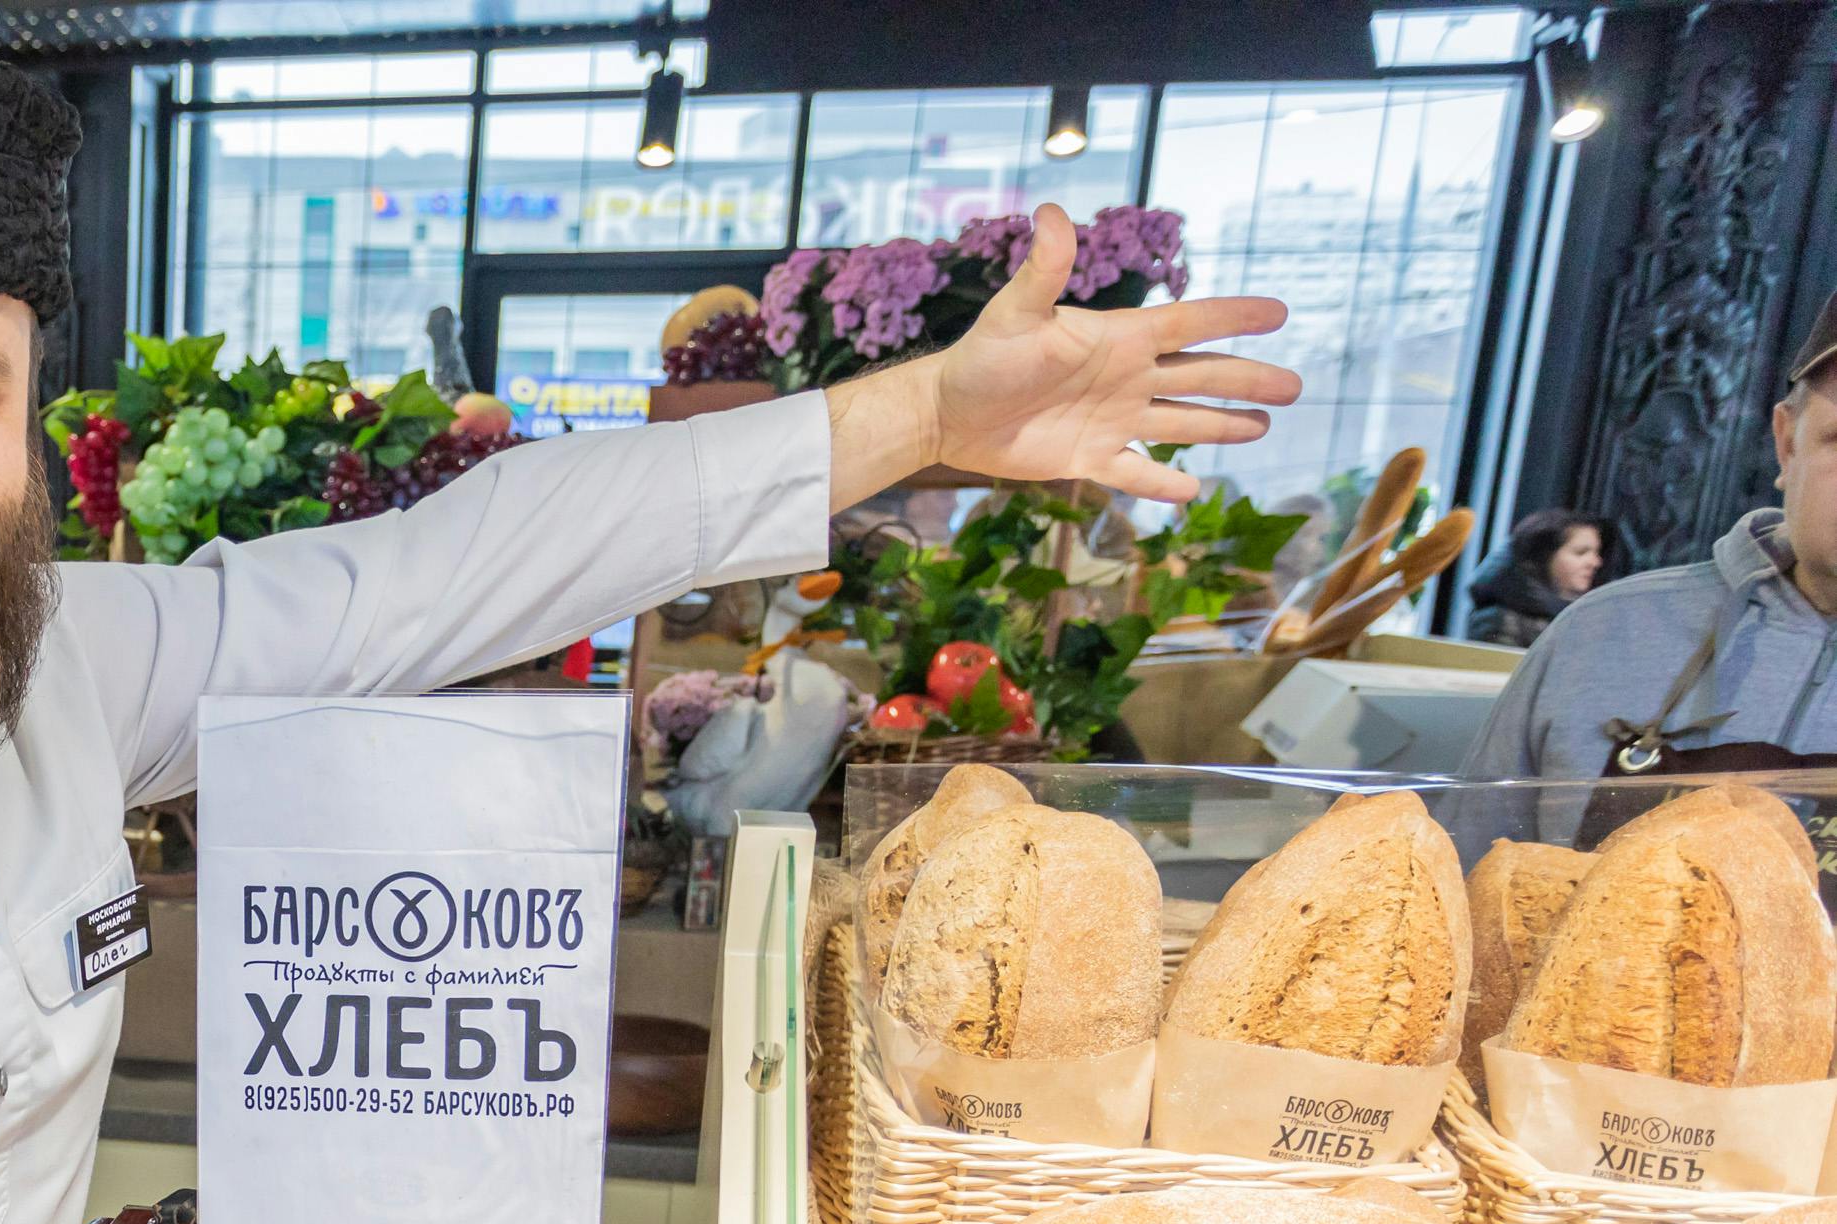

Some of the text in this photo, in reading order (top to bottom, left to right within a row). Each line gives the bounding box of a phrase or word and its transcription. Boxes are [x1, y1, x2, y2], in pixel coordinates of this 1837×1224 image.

[534, 383, 650, 416] ЛЕНТА
[88, 894, 137, 926] МОСКОВСКИЕ
[96, 910, 131, 935] ЯРМАРКИ
[92, 944, 128, 973] Олег
[243, 993, 577, 1082] ХЛЕБЪ
[245, 1085, 575, 1118] 8(925)500-29-52 БАРСУКОВЪ.РФ
[1272, 1124, 1375, 1161] ХЛЕБЪ
[1595, 1141, 1705, 1183] ХЛЕБЪ
